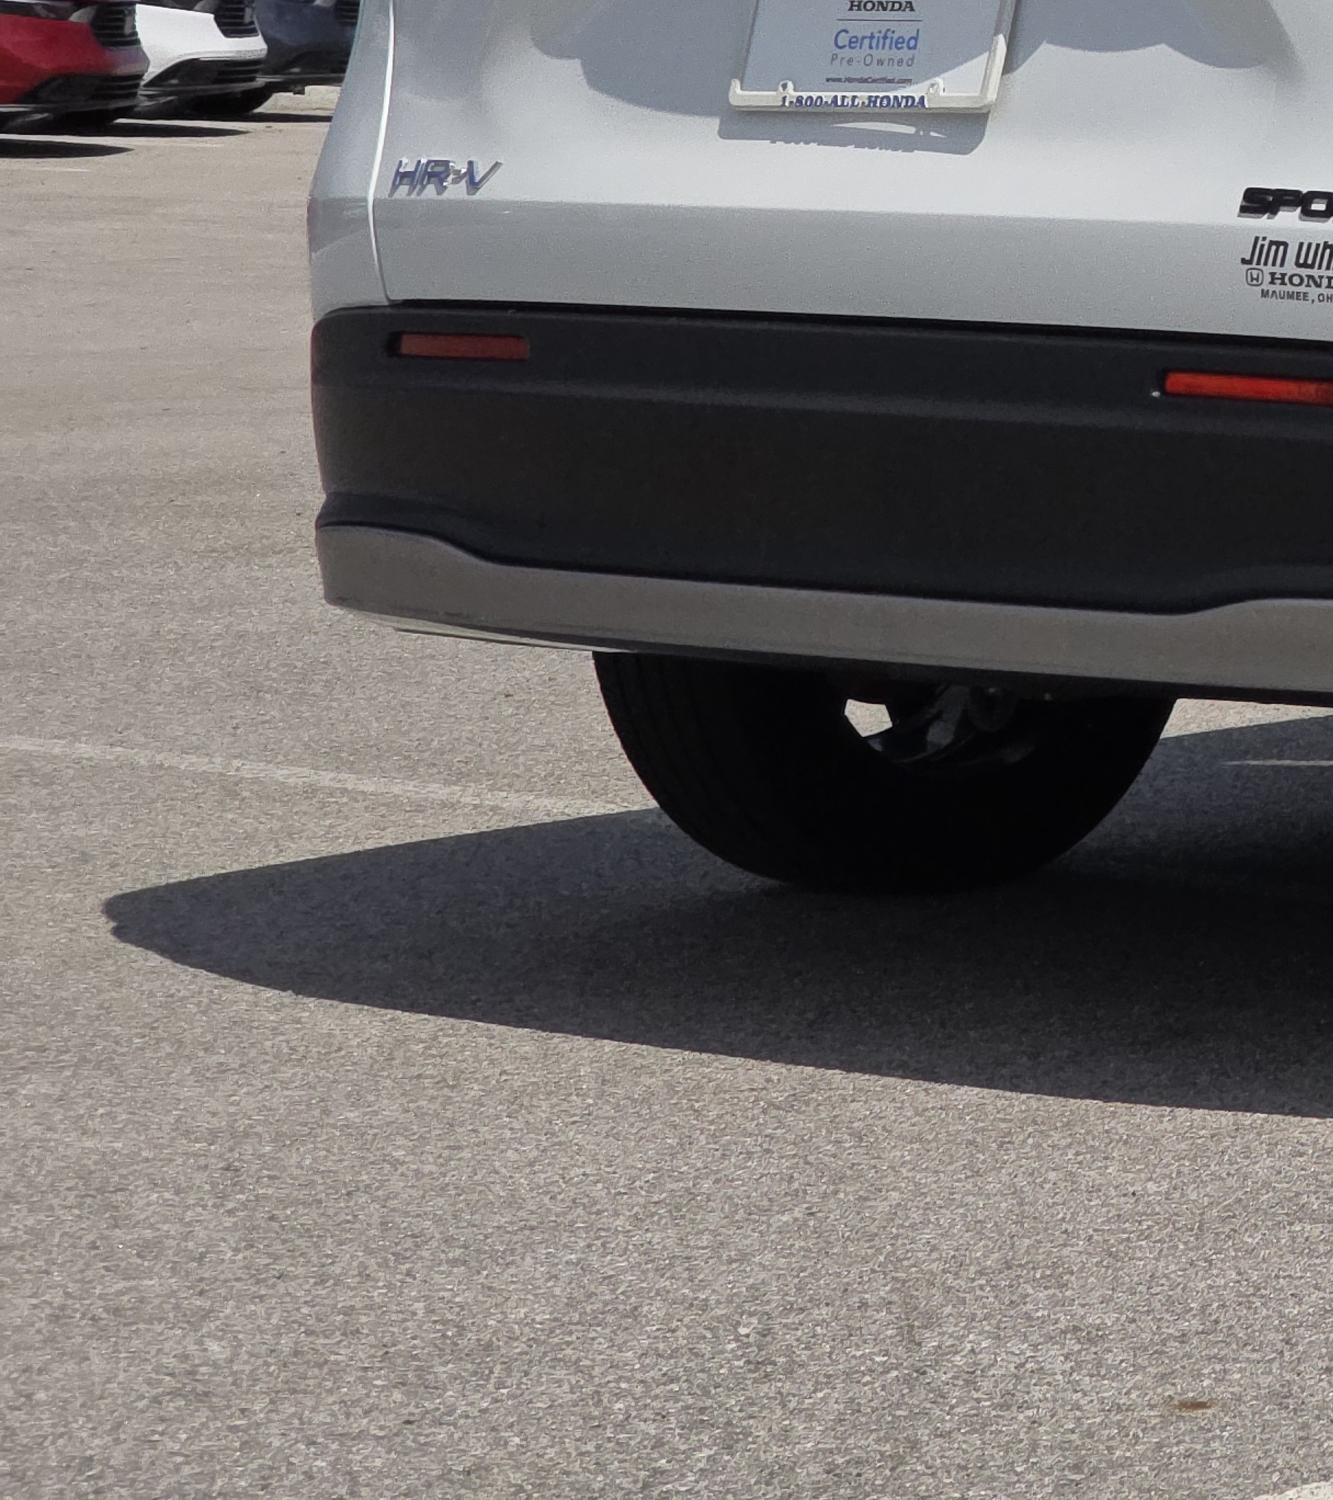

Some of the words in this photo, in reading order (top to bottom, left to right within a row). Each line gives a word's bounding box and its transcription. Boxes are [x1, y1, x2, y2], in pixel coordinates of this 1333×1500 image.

[848, 0, 915, 12] HONDA
[834, 29, 919, 50] Certified
[830, 53, 915, 67] Pre-Owned
[781, 95, 926, 108] 1-800-ALL-HONDA
[1240, 235, 1289, 268] Jim
